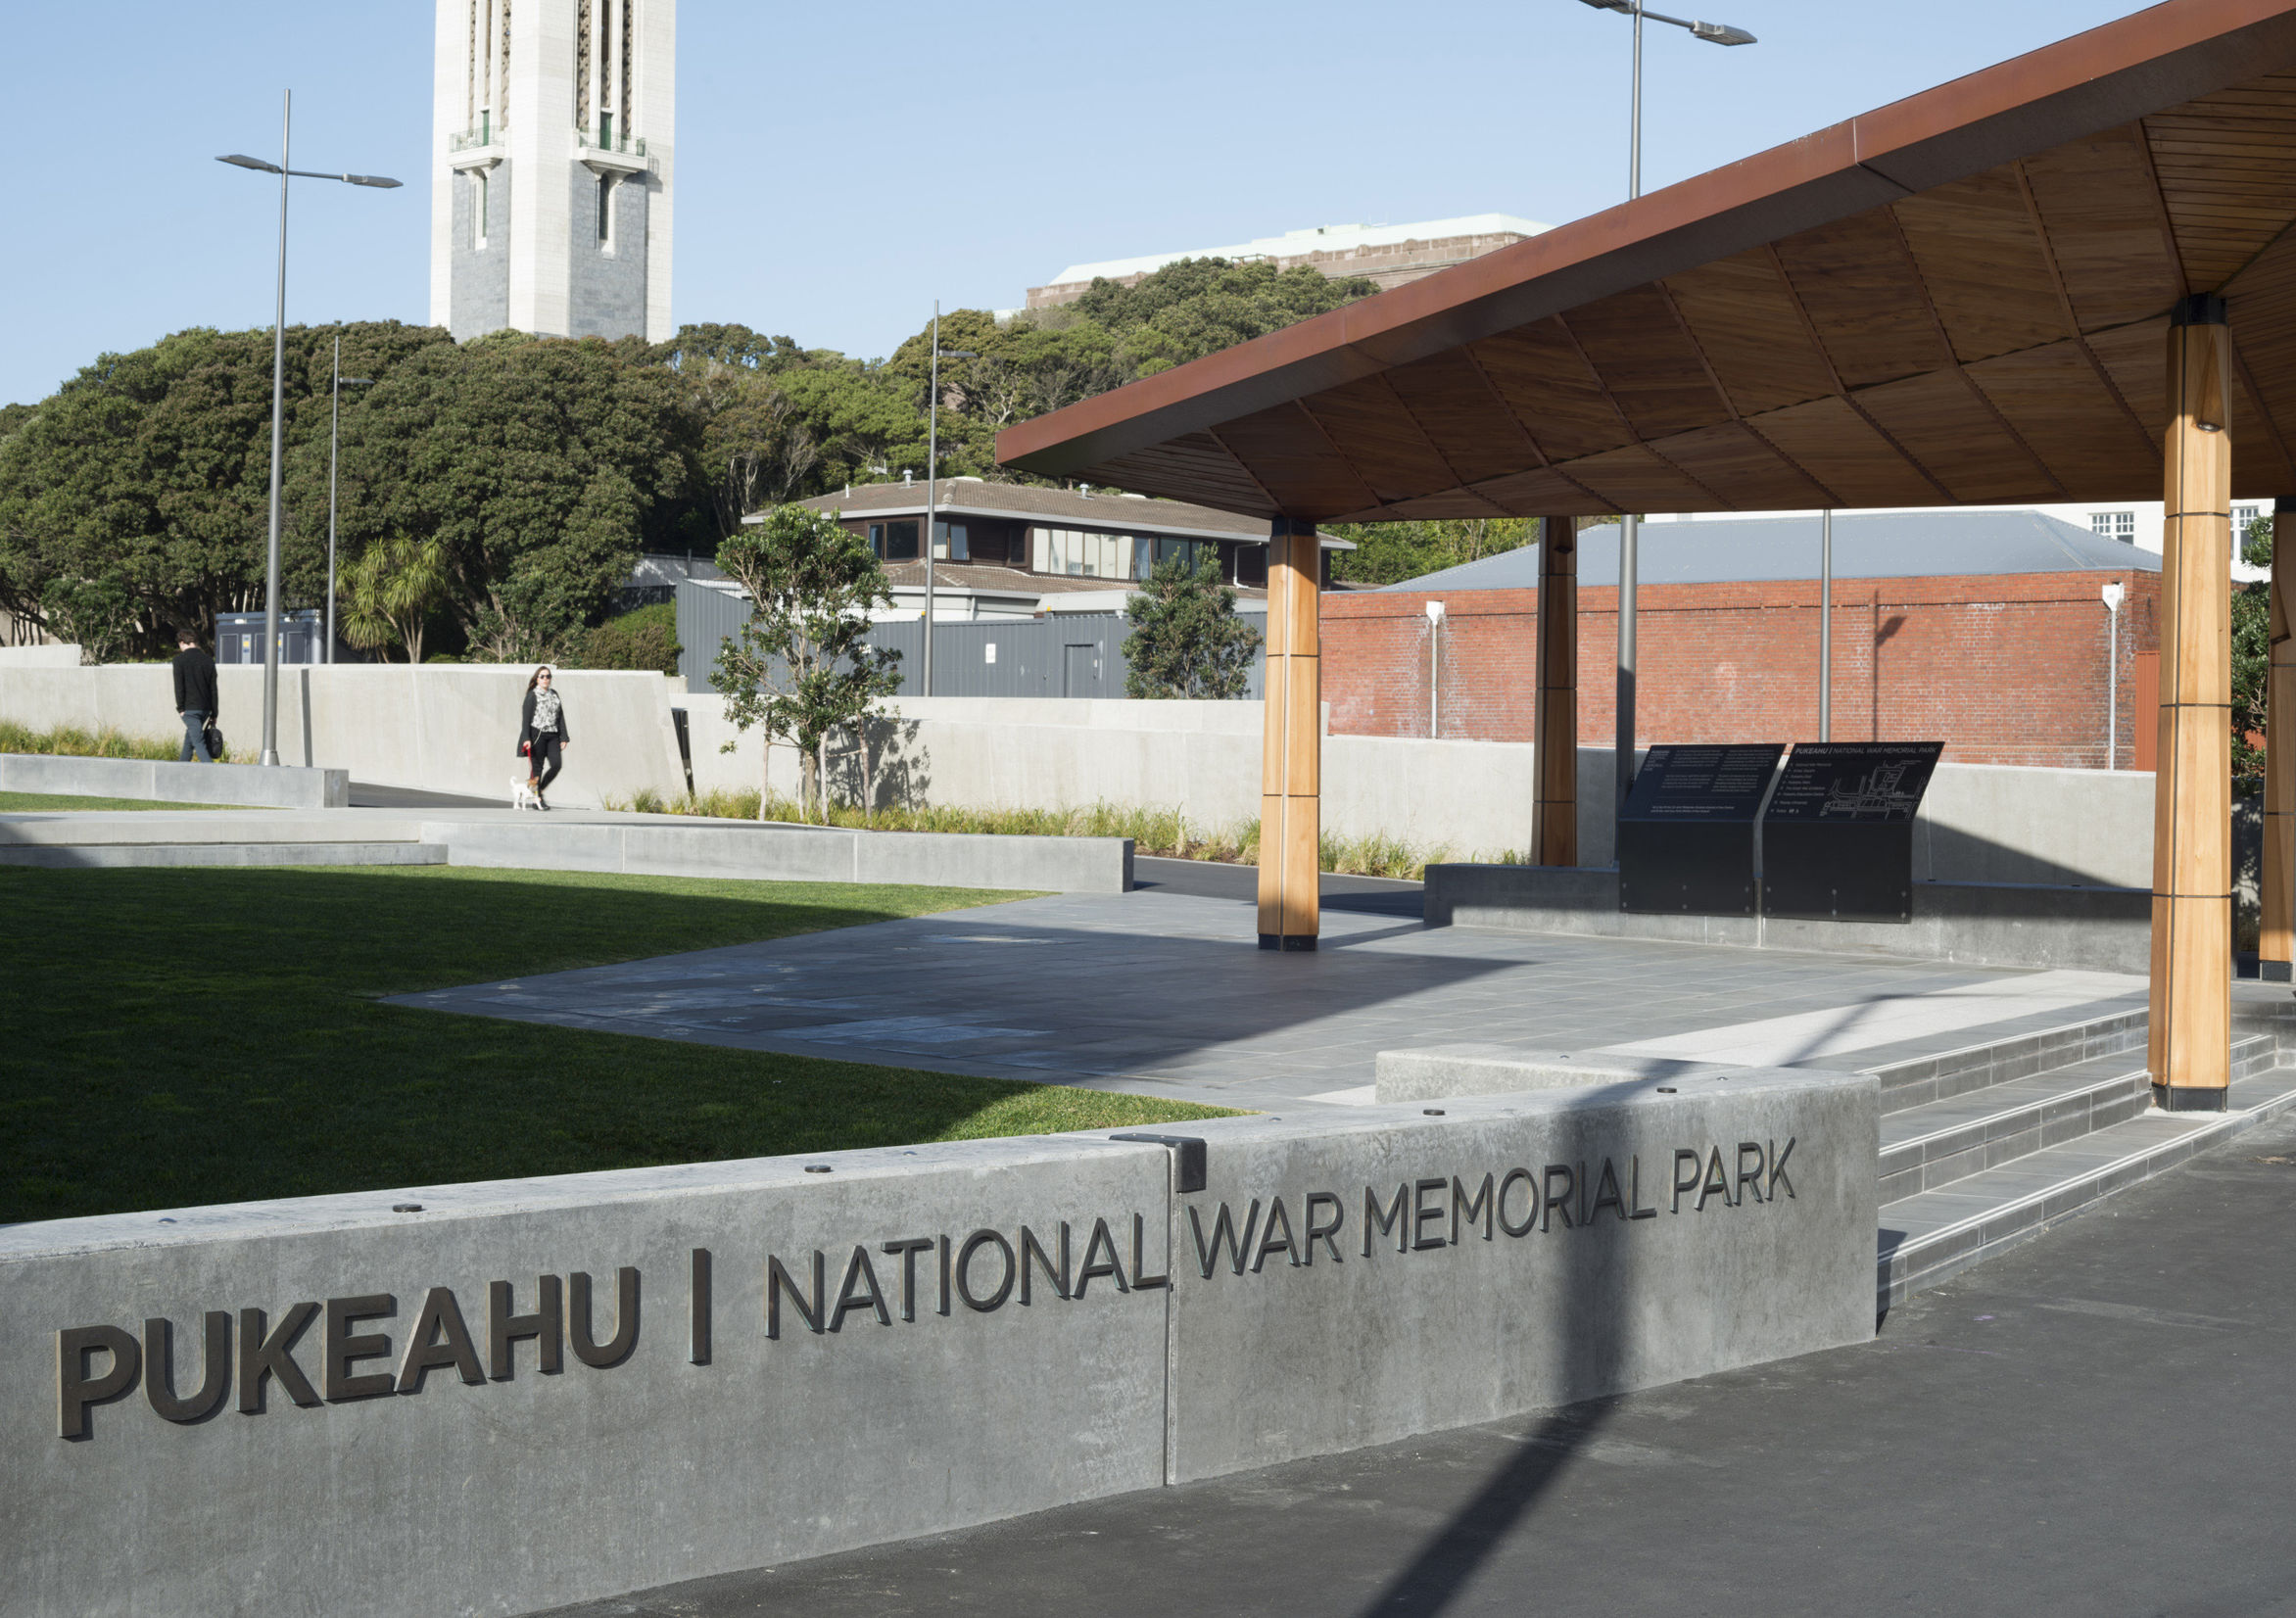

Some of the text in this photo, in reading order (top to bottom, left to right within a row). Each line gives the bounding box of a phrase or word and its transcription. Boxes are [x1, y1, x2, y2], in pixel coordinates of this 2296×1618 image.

[56, 1266, 642, 1441] PUKEAHU
[764, 1212, 1171, 1339] NATIONAL
[1186, 1191, 1344, 1278] WAR
[1361, 1154, 1657, 1259] MEMORIAL
[1670, 1137, 1796, 1214] PARK
